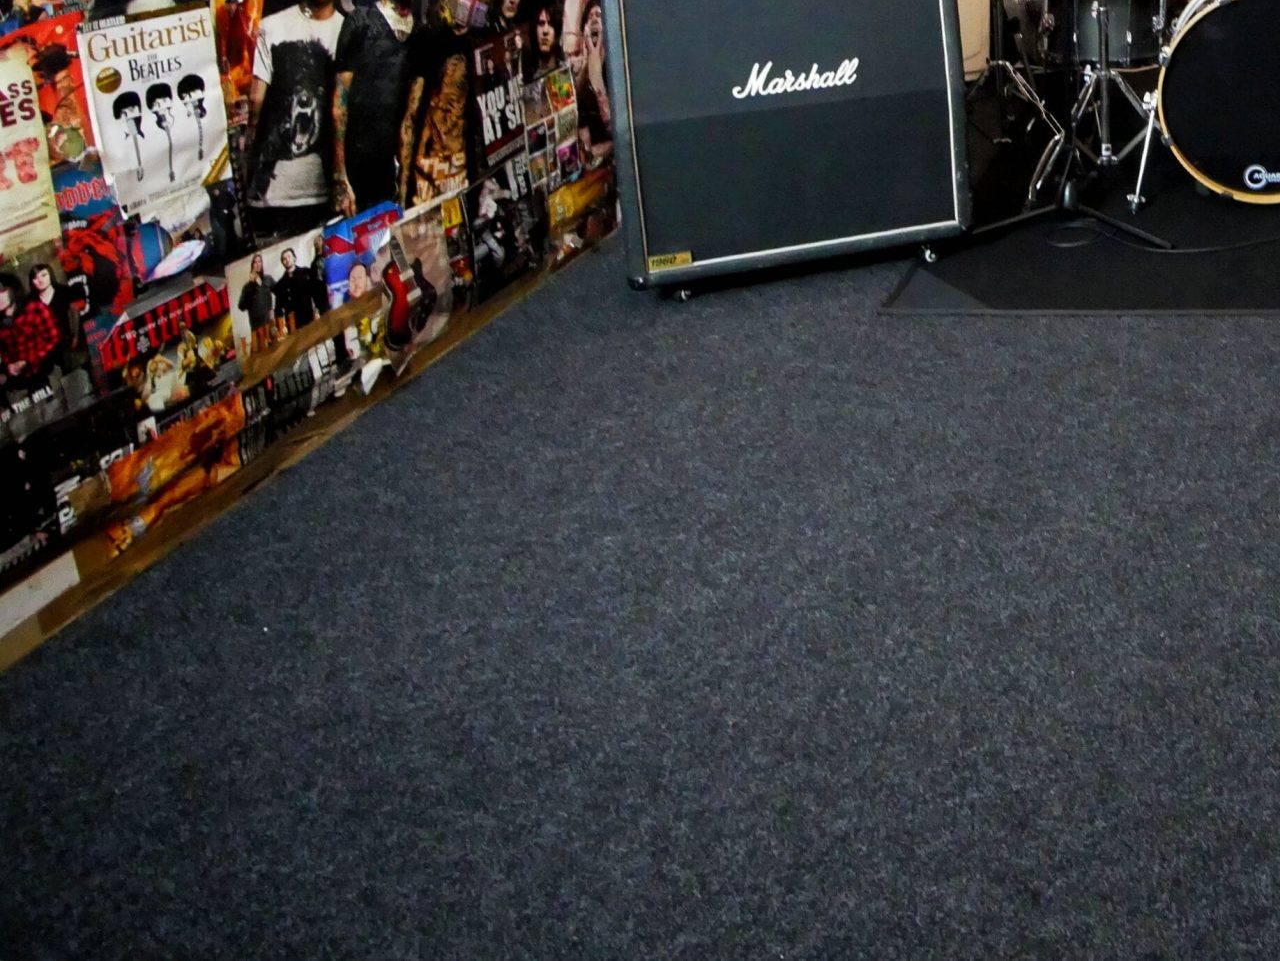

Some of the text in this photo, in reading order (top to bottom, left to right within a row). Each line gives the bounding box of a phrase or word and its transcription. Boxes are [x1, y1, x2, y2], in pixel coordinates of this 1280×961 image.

[86, 13, 212, 63] Guitarist
[128, 56, 182, 82] BEATLES
[732, 57, 860, 99] Marshall
